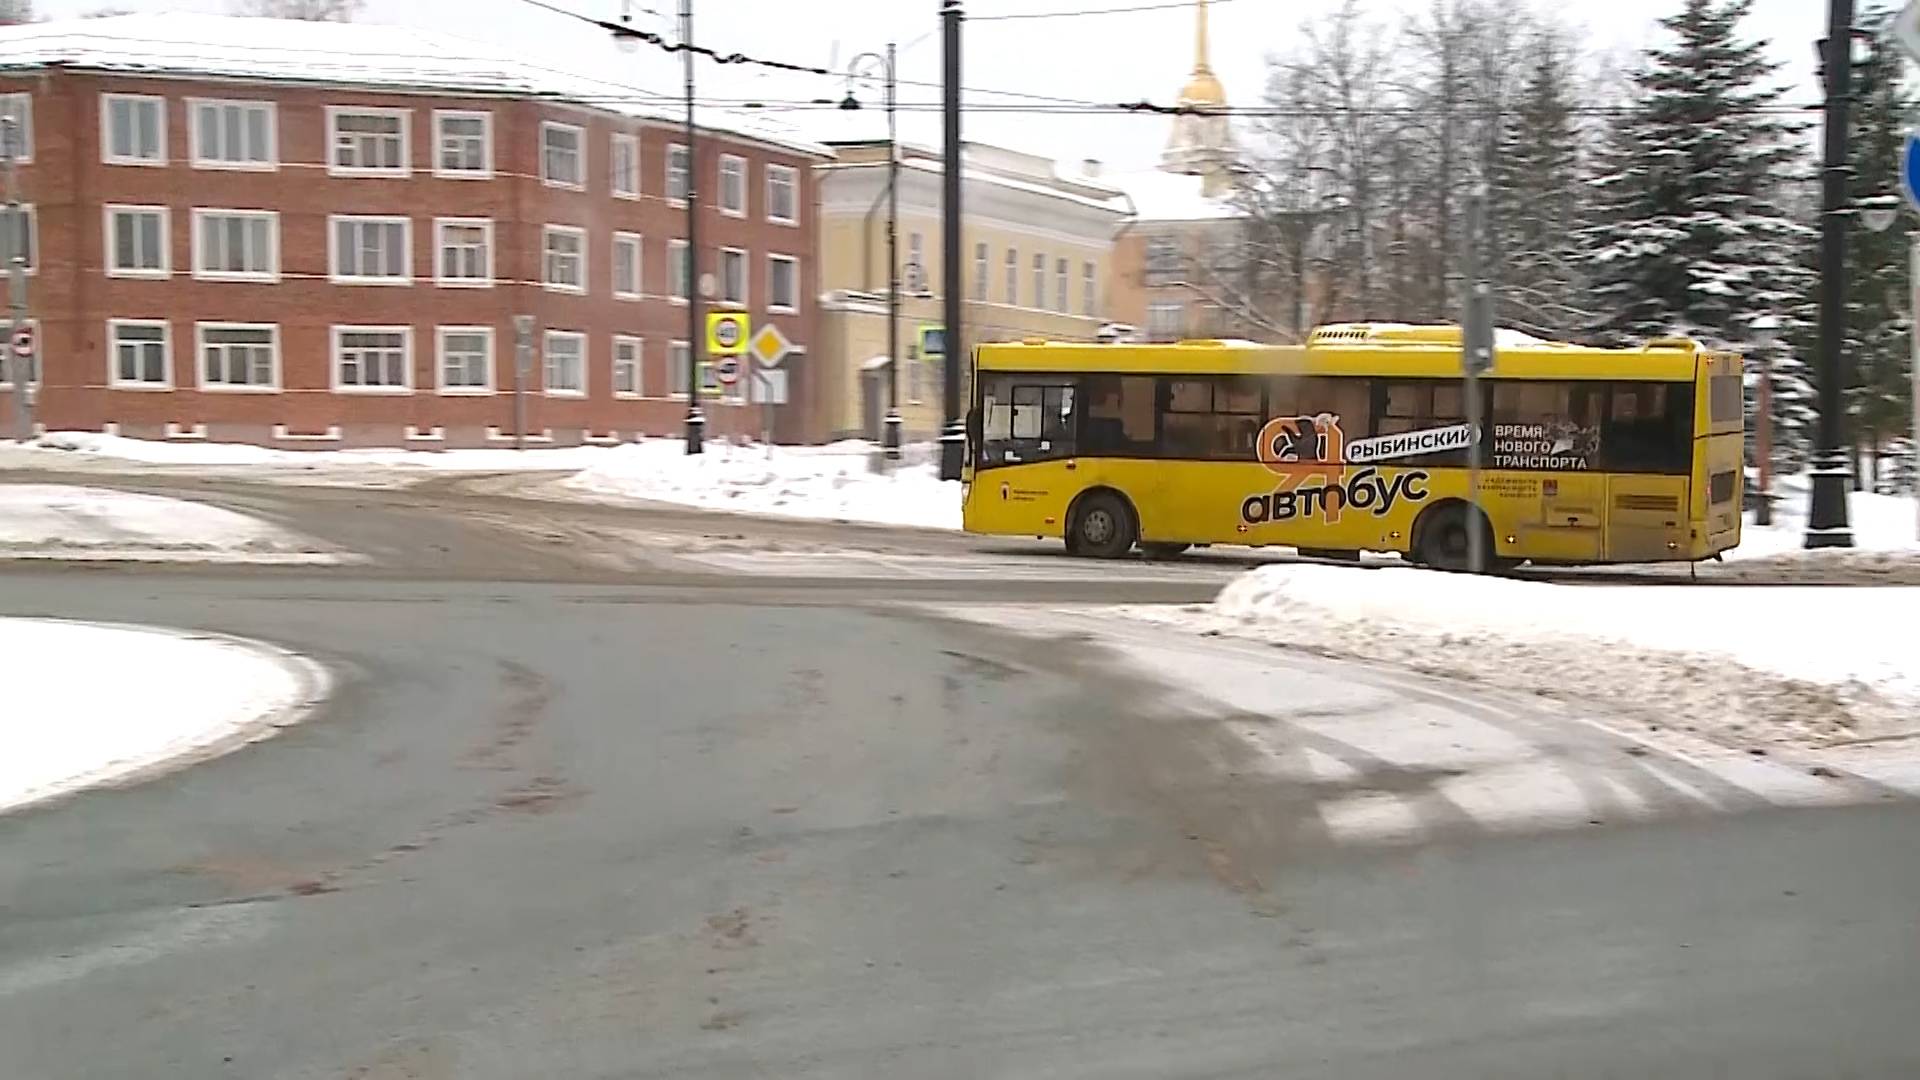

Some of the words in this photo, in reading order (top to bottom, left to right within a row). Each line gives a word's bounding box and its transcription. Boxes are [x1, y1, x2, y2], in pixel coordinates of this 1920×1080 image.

[1495, 425, 1542, 438] ВРЕМЯ
[1350, 425, 1471, 459] РЫБИНСКИЙ
[1495, 440, 1550, 453] НОВОГО
[1494, 455, 1587, 469] ТРАНСПОРТА
[1242, 469, 1428, 525] автобус
